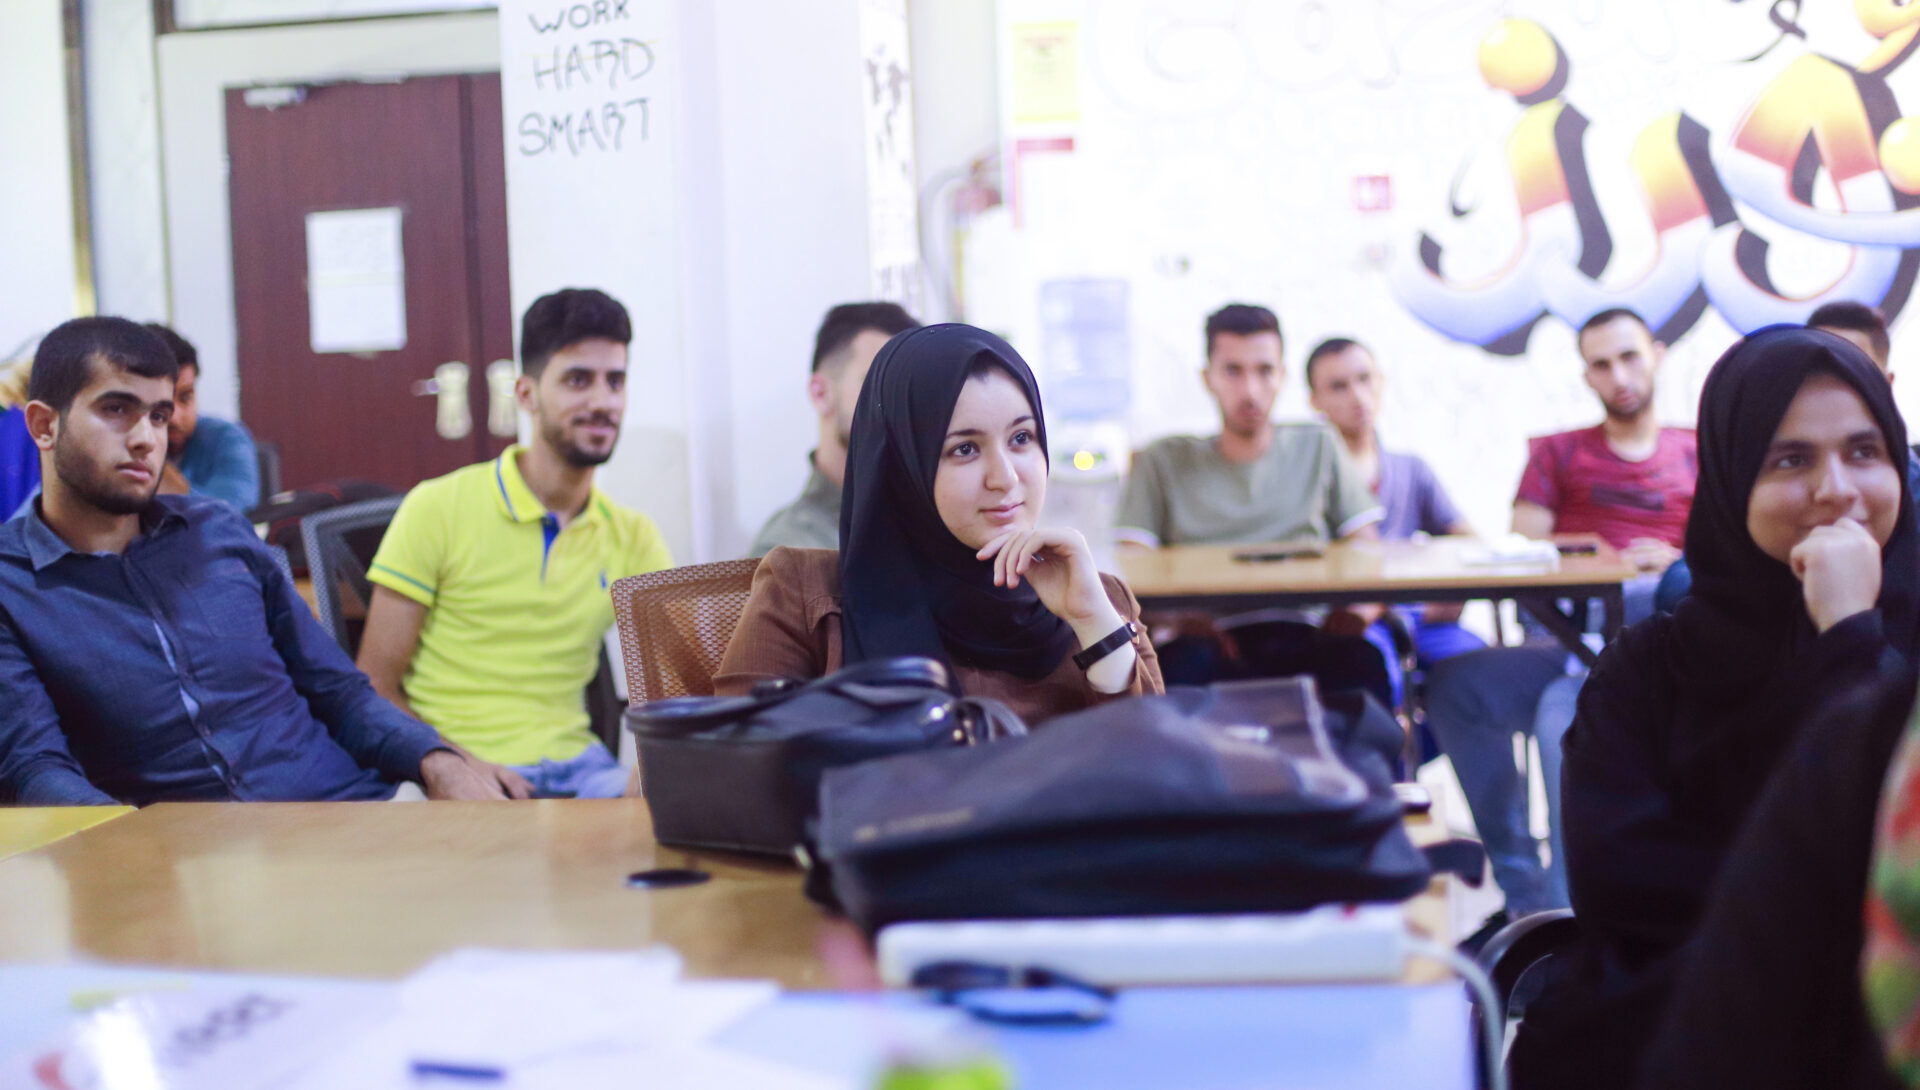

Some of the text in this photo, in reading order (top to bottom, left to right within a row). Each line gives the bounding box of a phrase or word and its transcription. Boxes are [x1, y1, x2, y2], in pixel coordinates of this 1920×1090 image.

[528, 0, 630, 33] WORK
[533, 37, 655, 91] HARD
[518, 97, 651, 157] SMART
